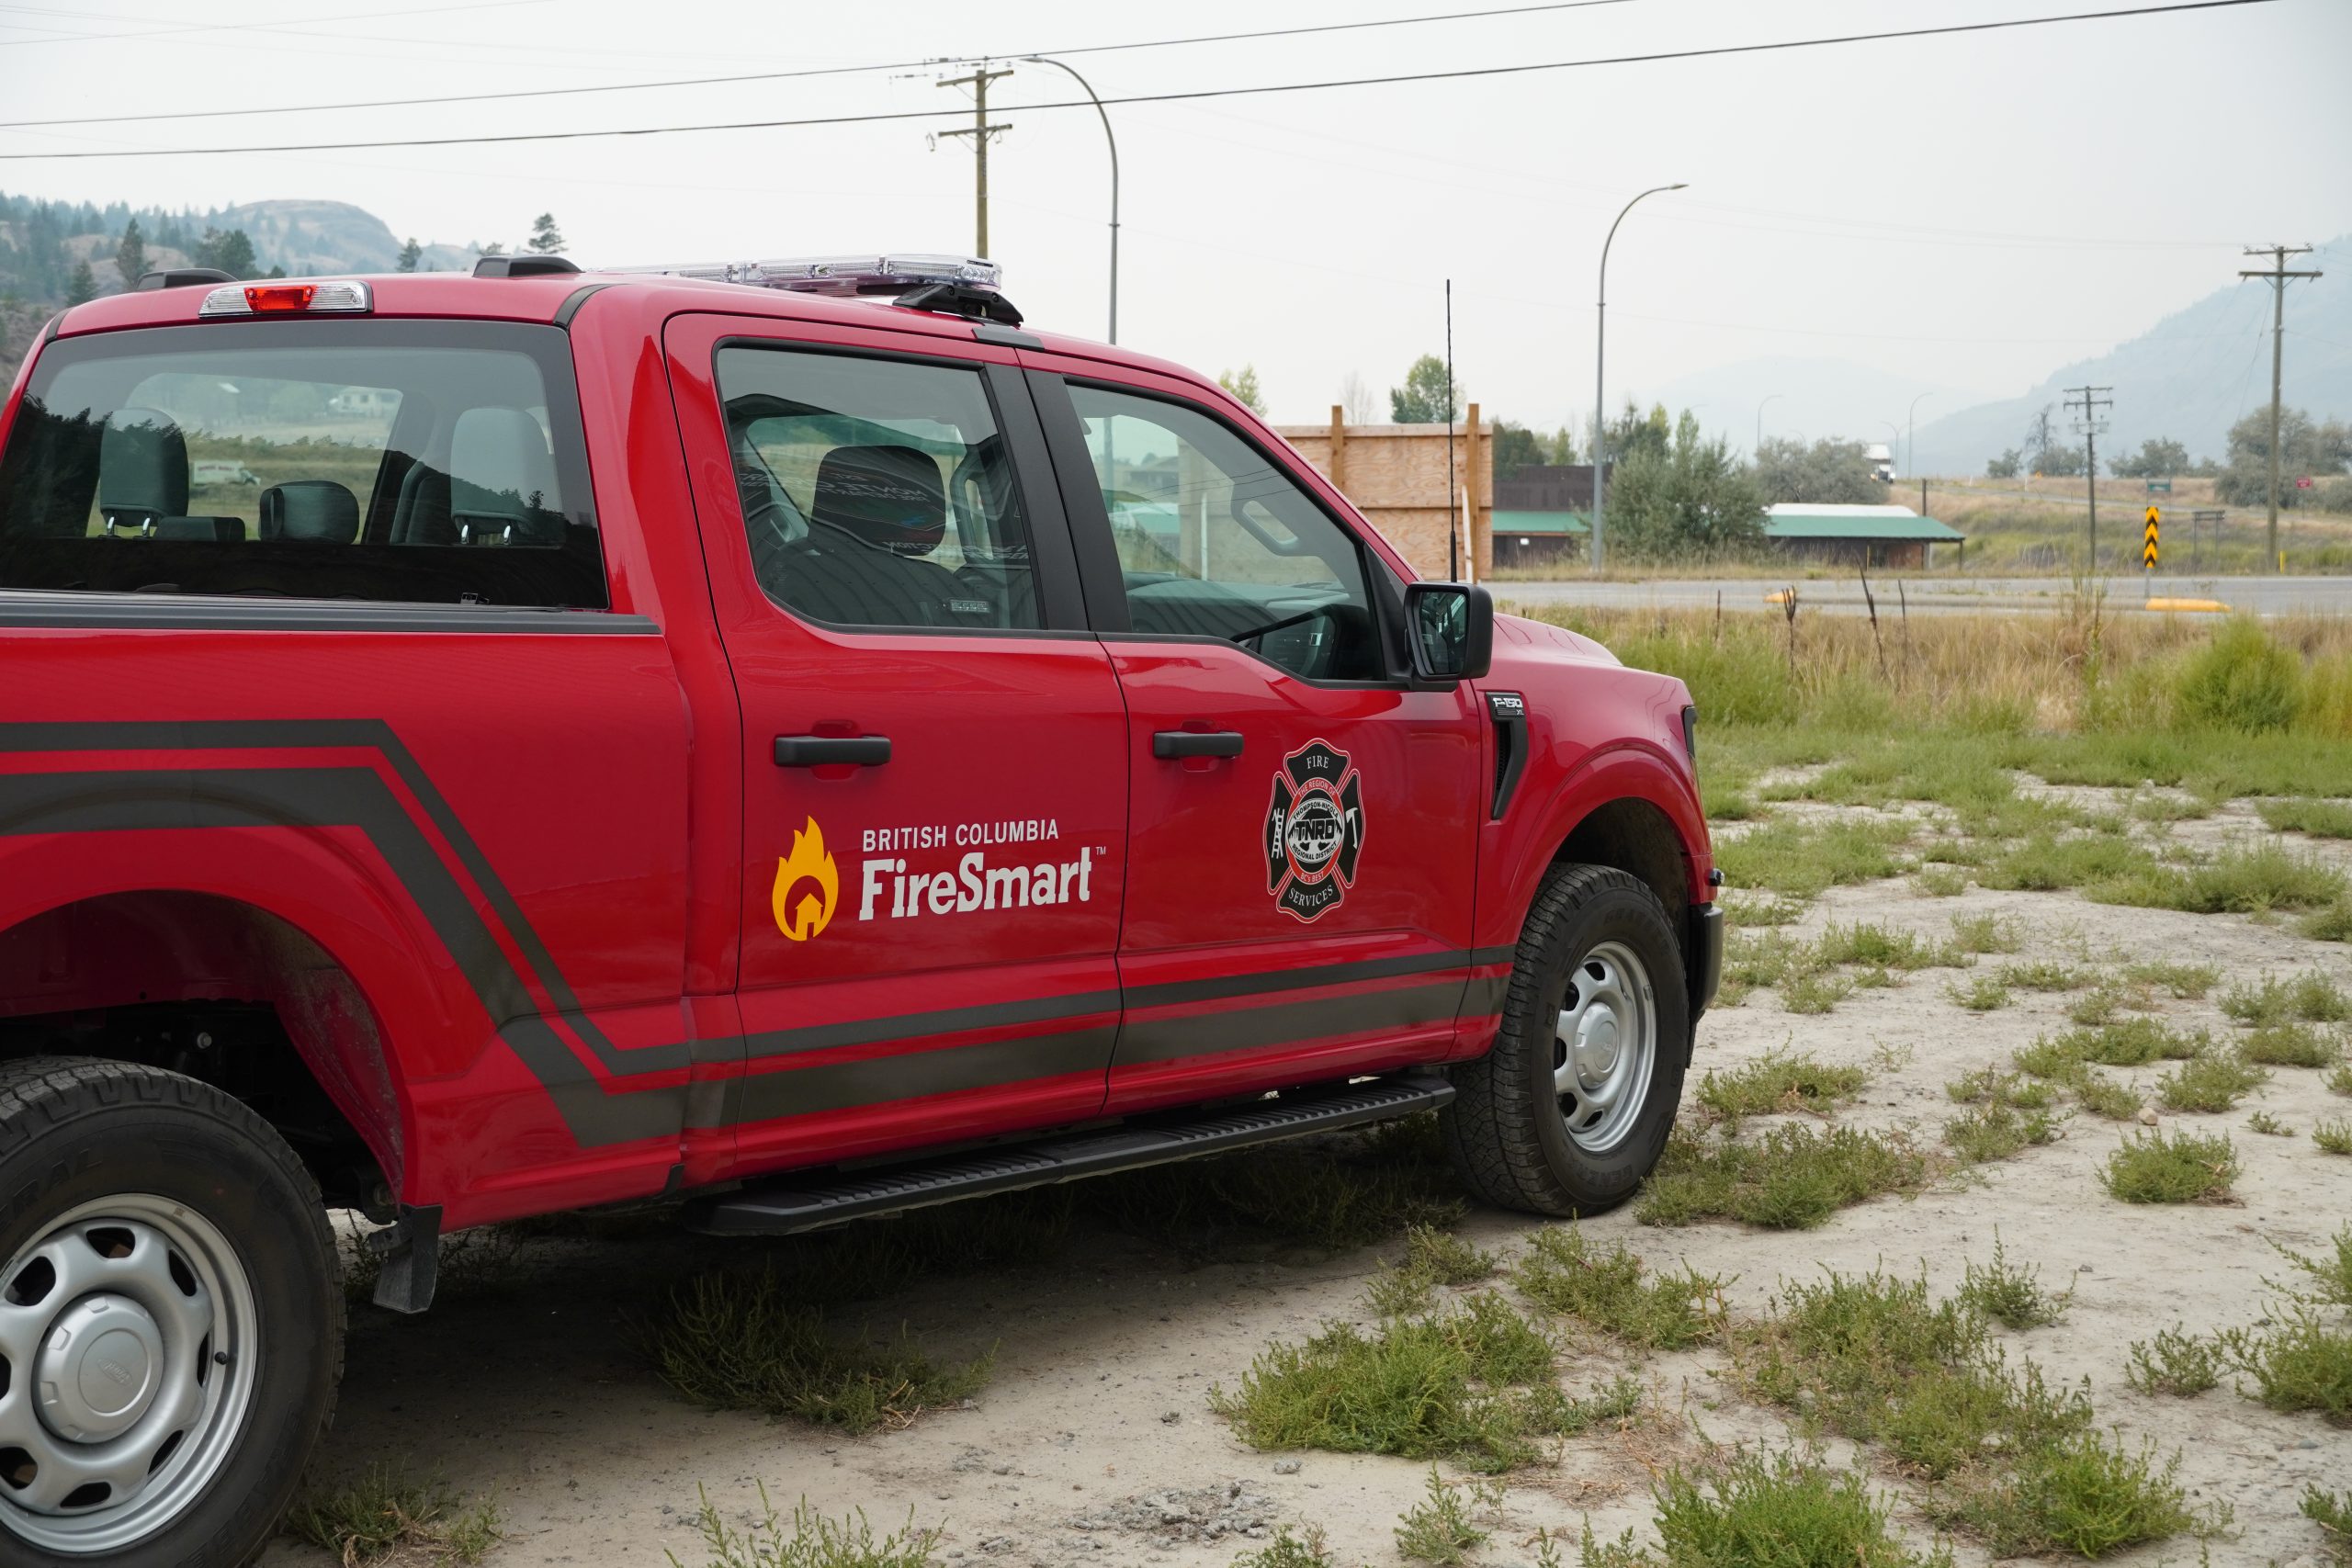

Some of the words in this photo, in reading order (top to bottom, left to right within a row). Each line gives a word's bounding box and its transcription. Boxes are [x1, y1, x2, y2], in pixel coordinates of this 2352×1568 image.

[1493, 697, 1523, 708] F-150
[1306, 755, 1329, 770] FIRE
[1298, 784, 1308, 797] THE
[1308, 780, 1329, 790] REGION
[1294, 802, 1339, 819] THOMPSON-NICOLA
[862, 825, 947, 852] BRITISH
[955, 818, 1058, 847] COLUMBIA
[1295, 819, 1335, 840] TNRD
[1292, 843, 1315, 860] REGIONAL
[1316, 840, 1337, 860] DISTRICT
[858, 846, 1092, 921] FireSmart
[1312, 871, 1324, 882] BEST
[1288, 885, 1333, 907] SERVICES
